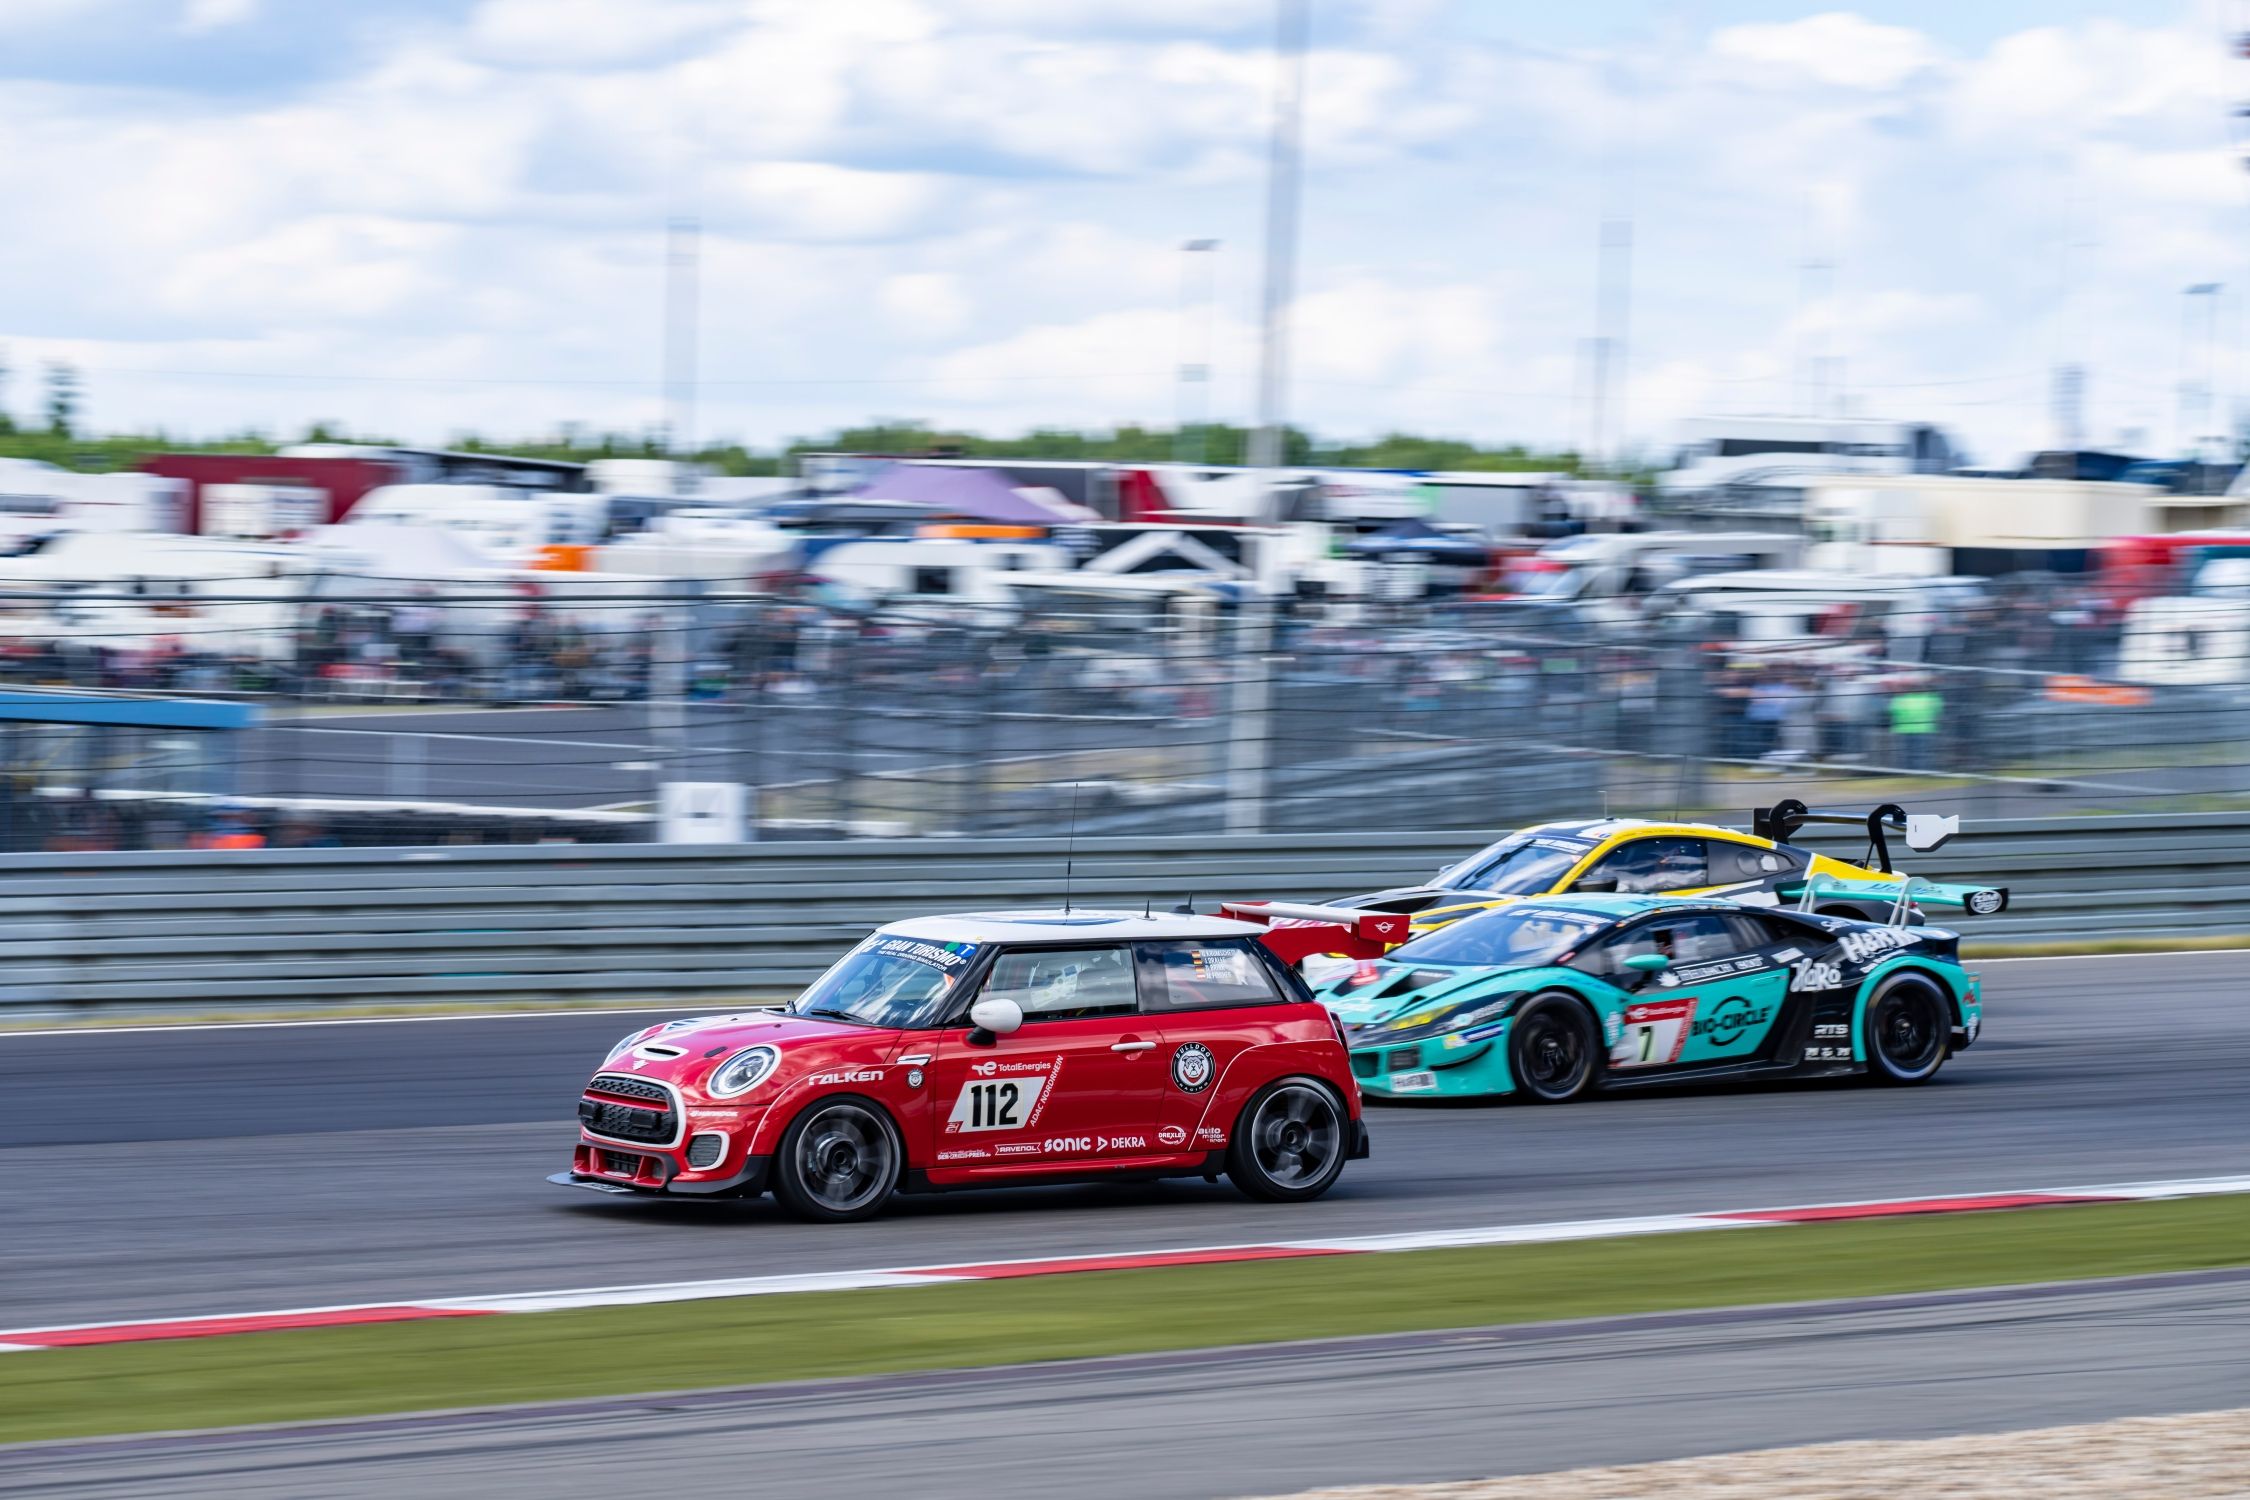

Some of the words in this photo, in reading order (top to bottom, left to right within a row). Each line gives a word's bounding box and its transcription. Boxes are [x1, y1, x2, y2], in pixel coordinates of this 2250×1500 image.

[881, 939, 916, 952] GRAN
[908, 942, 962, 966] TURISMO
[915, 956, 948, 972] SIMULATOR
[1691, 1006, 1770, 1036] BIO-CIRCLE
[1175, 1043, 1212, 1059] BULLDOG
[1639, 1025, 1654, 1062] 7
[998, 1061, 1051, 1072] TotalEnergies
[808, 1070, 884, 1086] FALKEN
[1030, 1104, 1044, 1127] ADAC
[1041, 1054, 1064, 1104] NORDRHEIN
[971, 1083, 1018, 1127] 112
[999, 1145, 1037, 1154] RAVENOL
[1111, 1136, 1146, 1149] DEKRA
